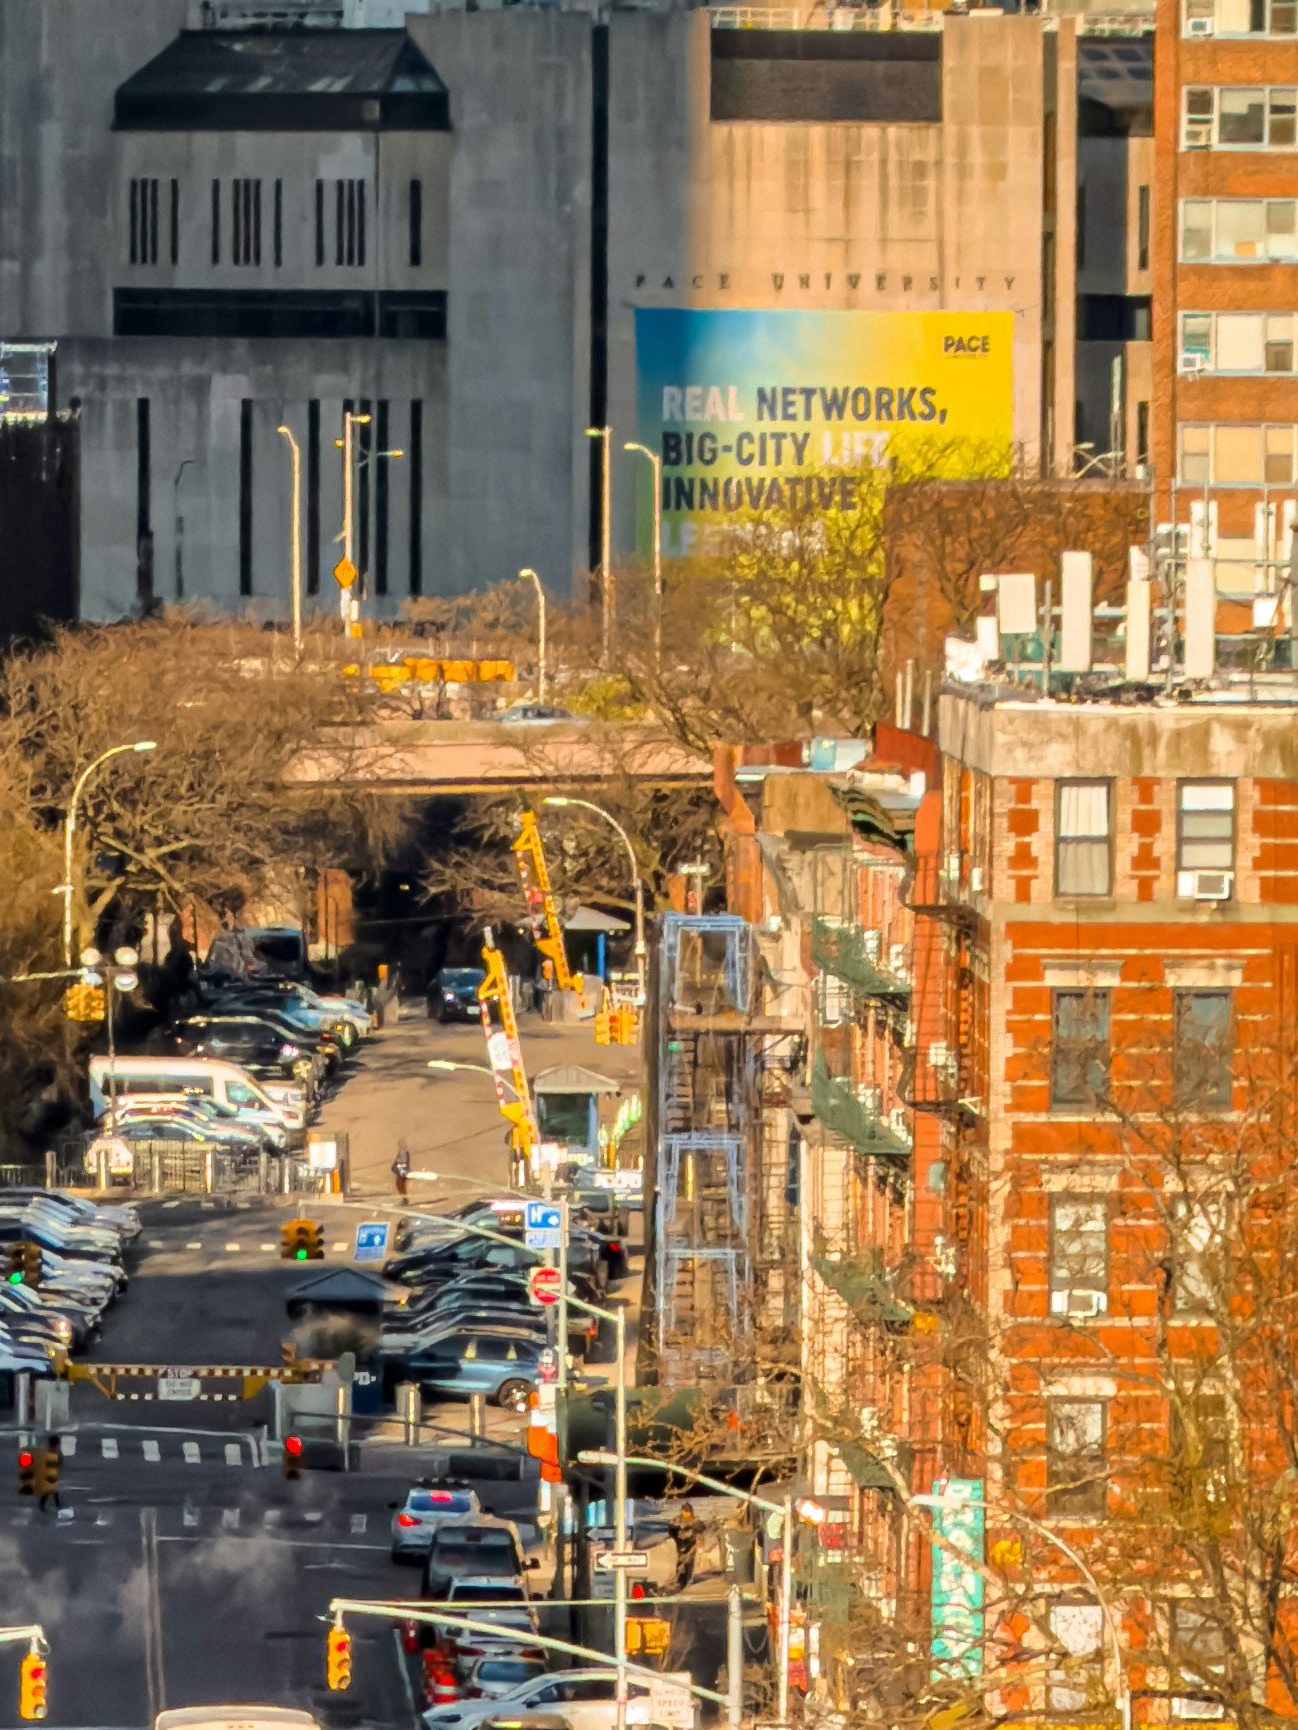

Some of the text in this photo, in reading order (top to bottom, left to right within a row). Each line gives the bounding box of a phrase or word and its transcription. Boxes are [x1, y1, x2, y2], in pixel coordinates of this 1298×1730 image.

[634, 273, 1017, 292] PACE UNIVERSITY
[943, 335, 991, 354] PACE
[662, 385, 948, 426] REAL NETWORKS,
[662, 431, 810, 467] BIG-CITY
[662, 476, 858, 513] INNOVATIVE
